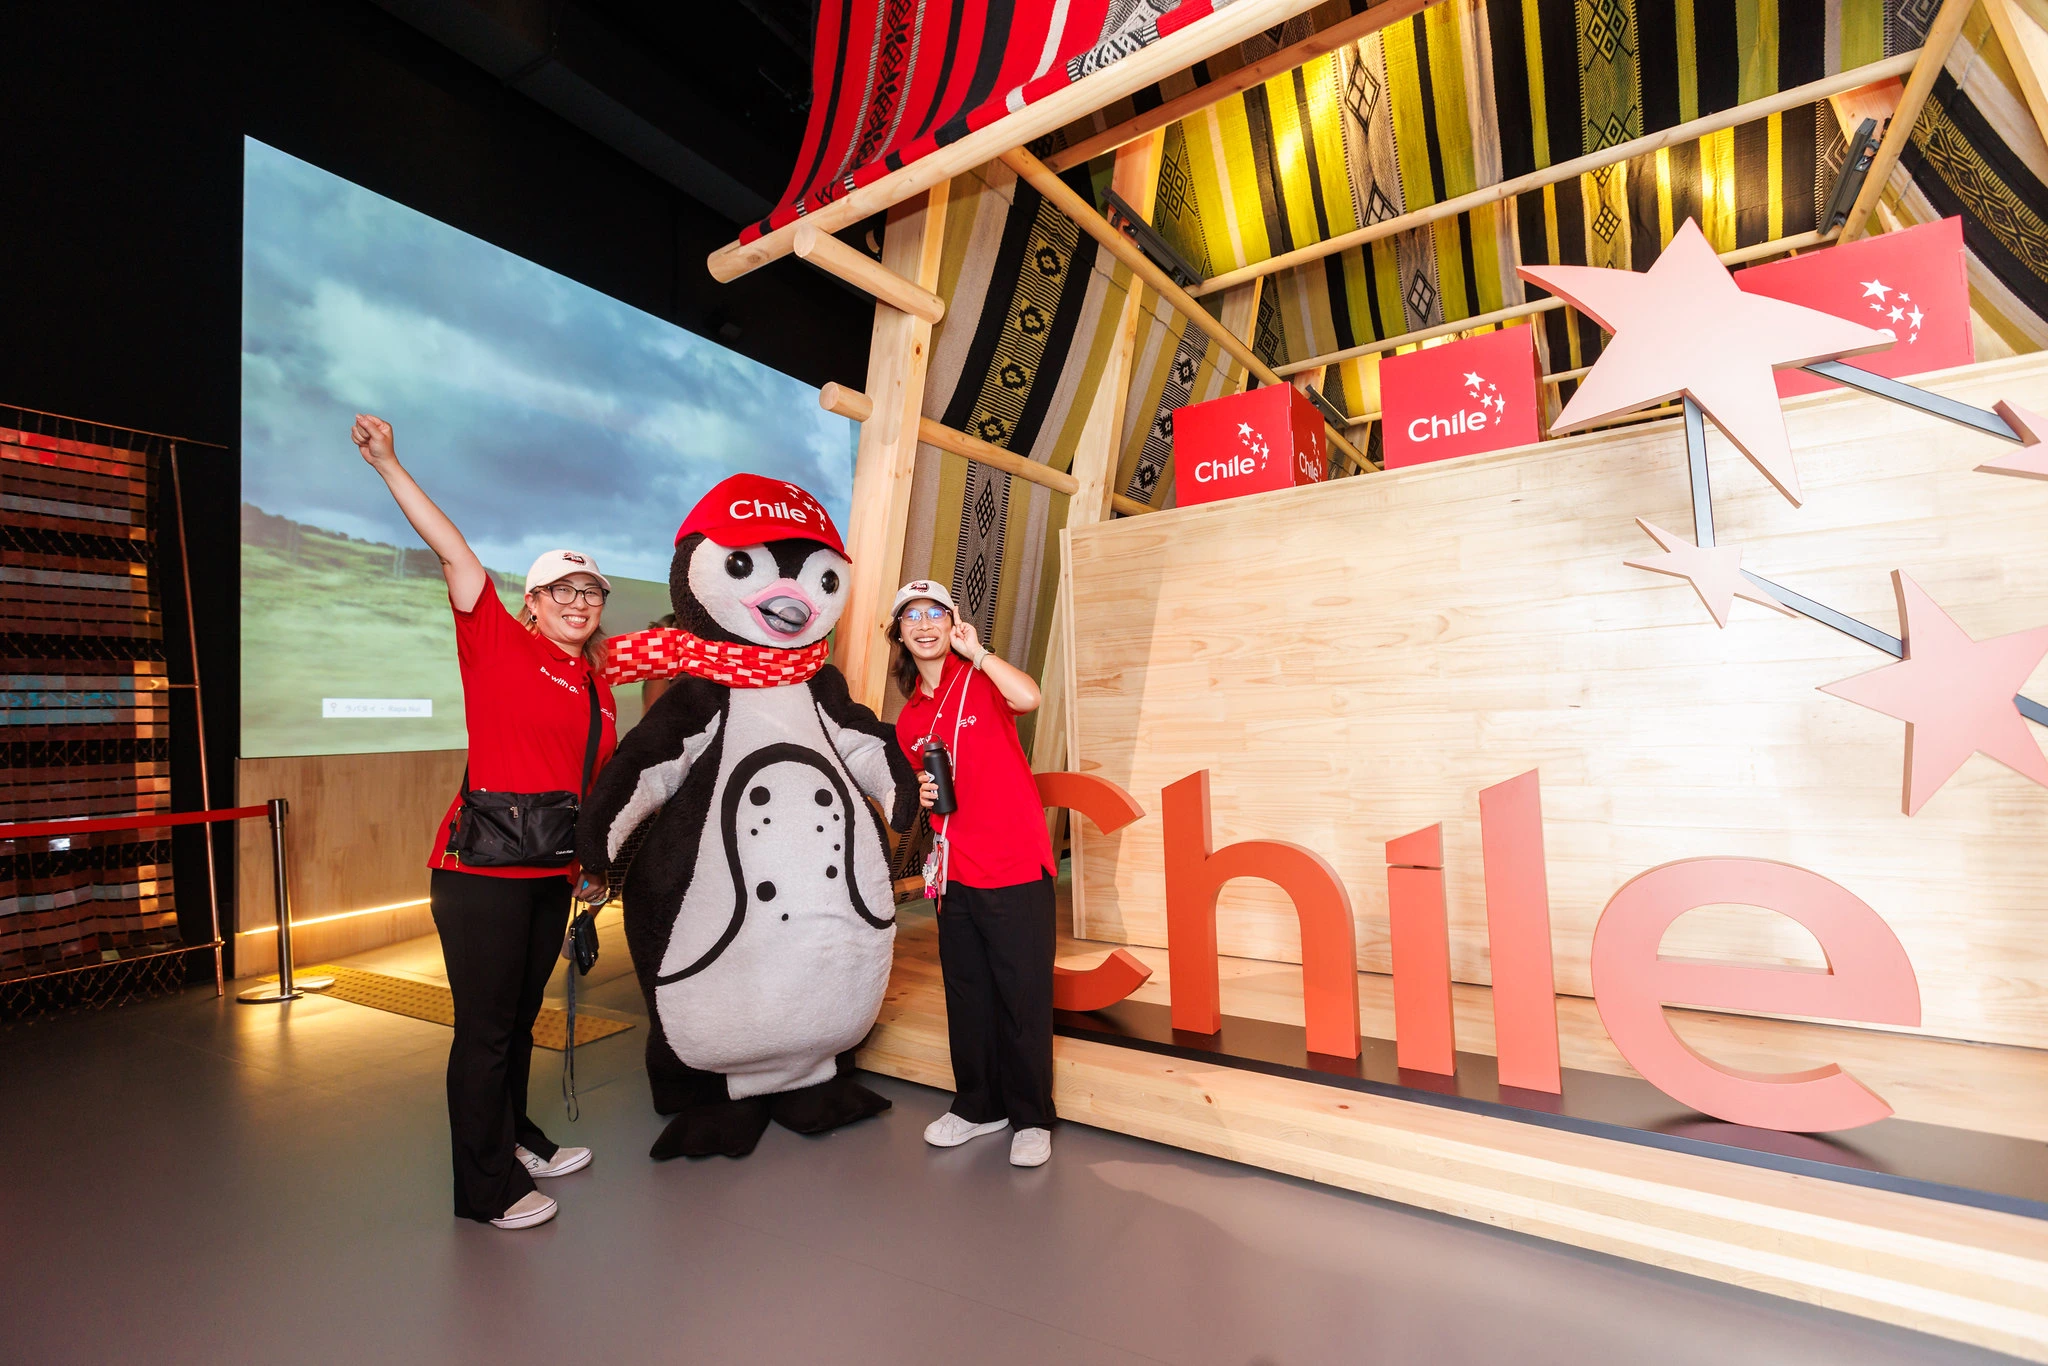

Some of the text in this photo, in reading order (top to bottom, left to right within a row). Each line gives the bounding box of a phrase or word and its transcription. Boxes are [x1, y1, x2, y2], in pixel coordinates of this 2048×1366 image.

[1406, 409, 1487, 442] Chile
[1194, 454, 1256, 483] Chile
[1299, 451, 1319, 482] Chile
[729, 499, 807, 523] Chile
